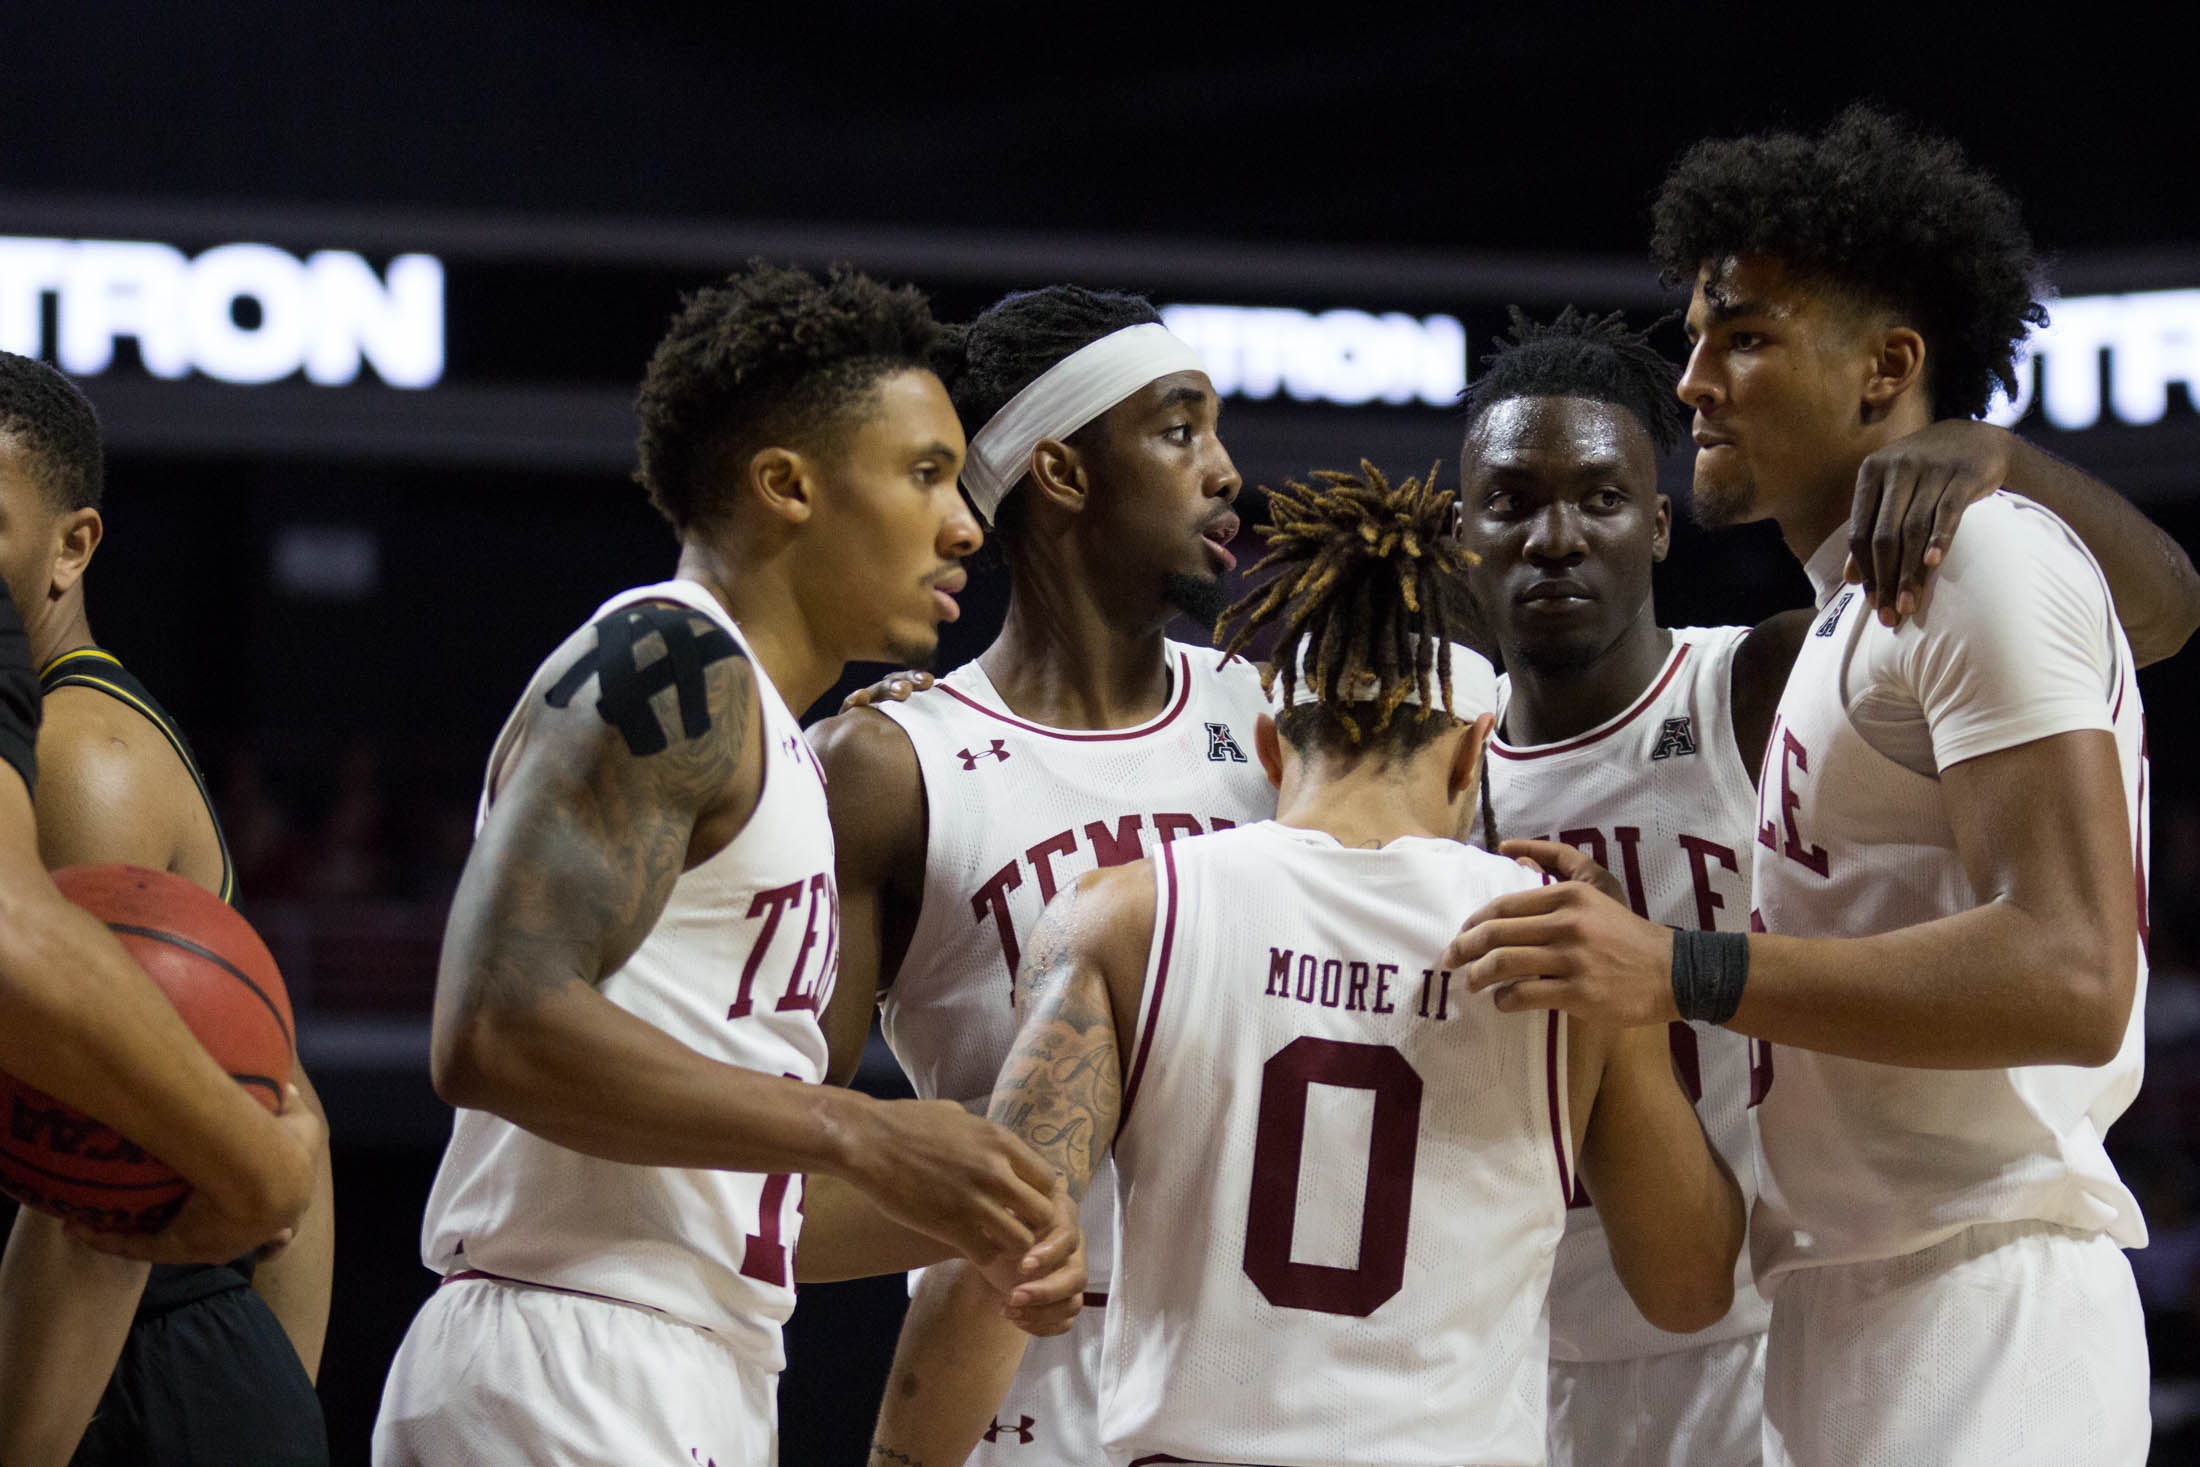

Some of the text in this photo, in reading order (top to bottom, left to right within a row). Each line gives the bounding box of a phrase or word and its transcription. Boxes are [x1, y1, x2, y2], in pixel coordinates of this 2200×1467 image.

[1265, 947, 1452, 1021] MOORE II
[1242, 1035, 1424, 1318] 0
